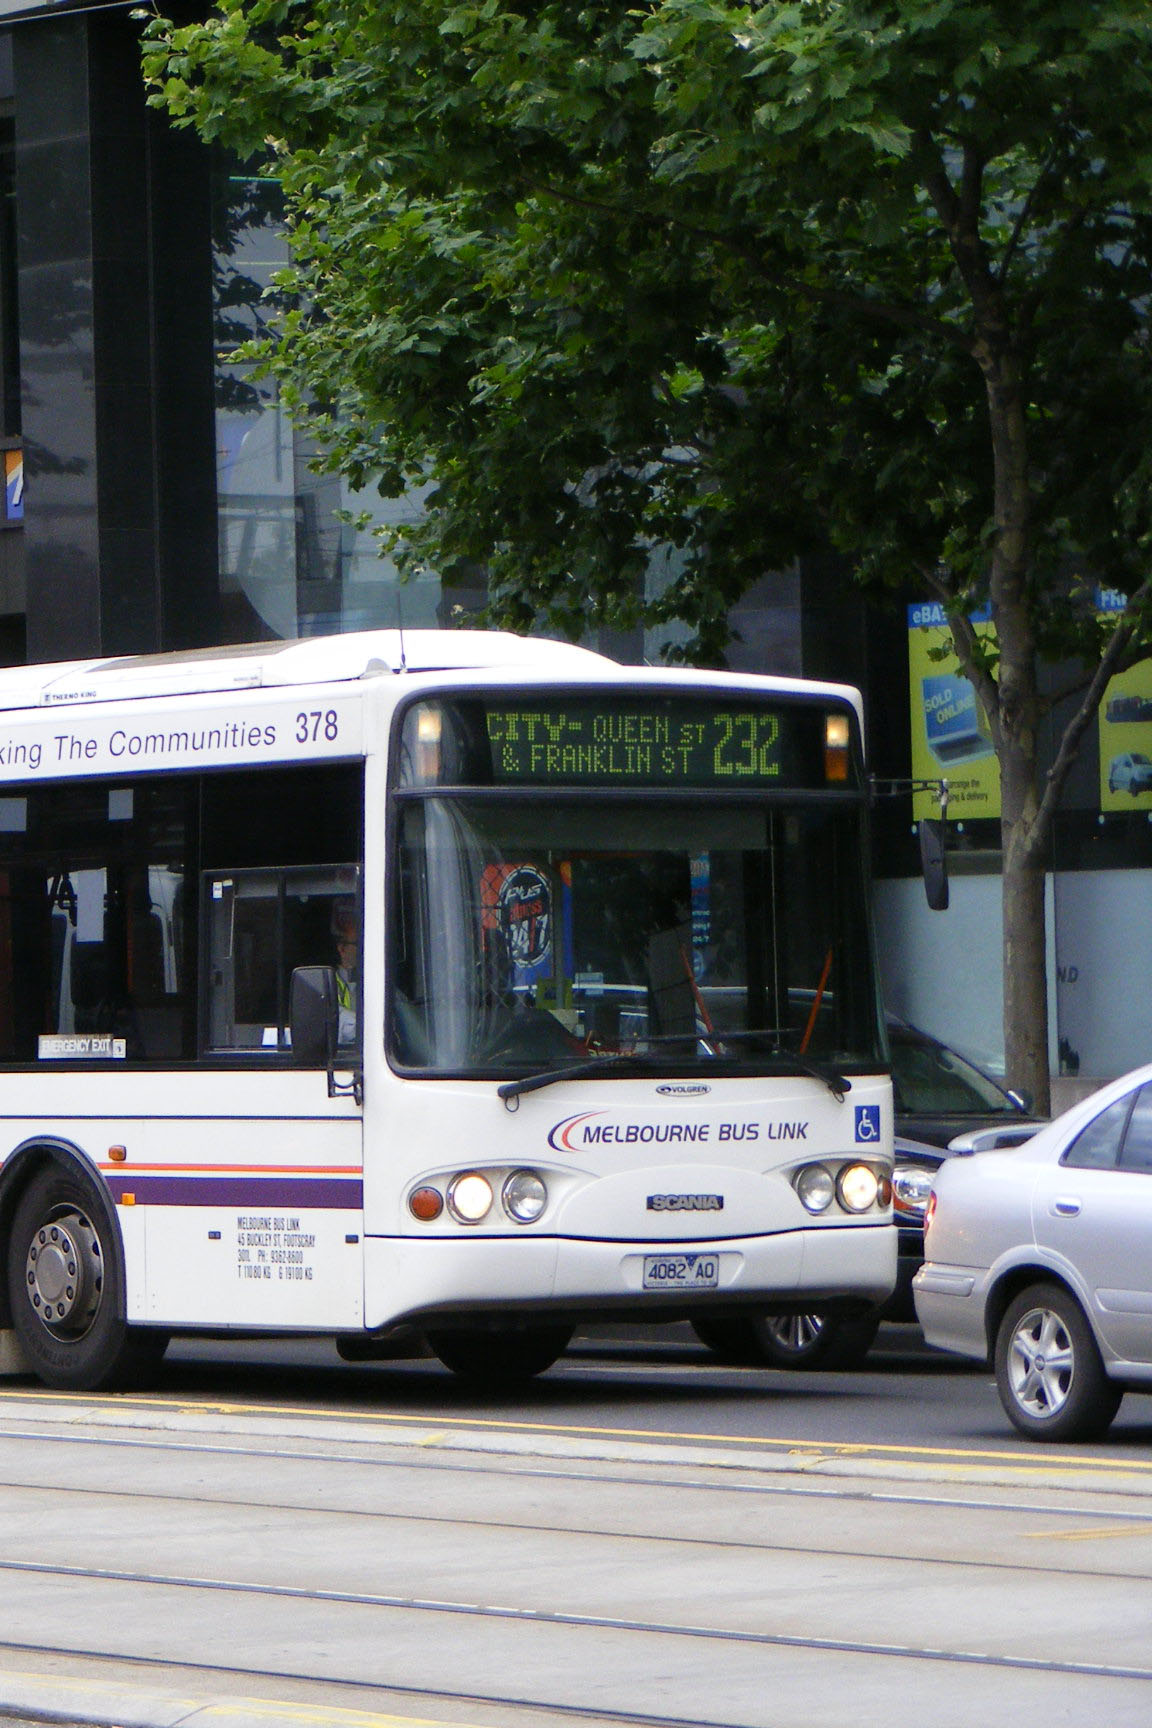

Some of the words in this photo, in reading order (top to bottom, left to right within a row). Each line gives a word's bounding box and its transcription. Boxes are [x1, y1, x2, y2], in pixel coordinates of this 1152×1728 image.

[925, 688, 952, 712] SOLD
[296, 709, 338, 744] 378
[593, 715, 669, 743] QUEEN
[680, 724, 705, 743] ST
[54, 734, 97, 761] The
[108, 722, 277, 756] Communities
[713, 713, 779, 775] 232
[502, 744, 519, 772] &
[531, 744, 650, 773] FRANKLIN
[662, 746, 693, 774] ST
[91, 1038, 111, 1052] EXIT
[671, 1085, 708, 1094] VOLGREN
[583, 1125, 710, 1143] MELBOURNE
[718, 1123, 760, 1141] BUS
[768, 1122, 809, 1140] LINK
[652, 1194, 720, 1211] SCANIA
[237, 1217, 272, 1230] MELBOURNE
[273, 1217, 285, 1231] BUS
[286, 1218, 300, 1231] LINK
[237, 1233, 245, 1246] 45
[247, 1233, 272, 1247] BUCKLEY
[283, 1234, 315, 1248] FOOTSCRAY
[263, 1266, 271, 1279] KG
[304, 1267, 313, 1280] KG
[648, 1263, 686, 1279] 4082
